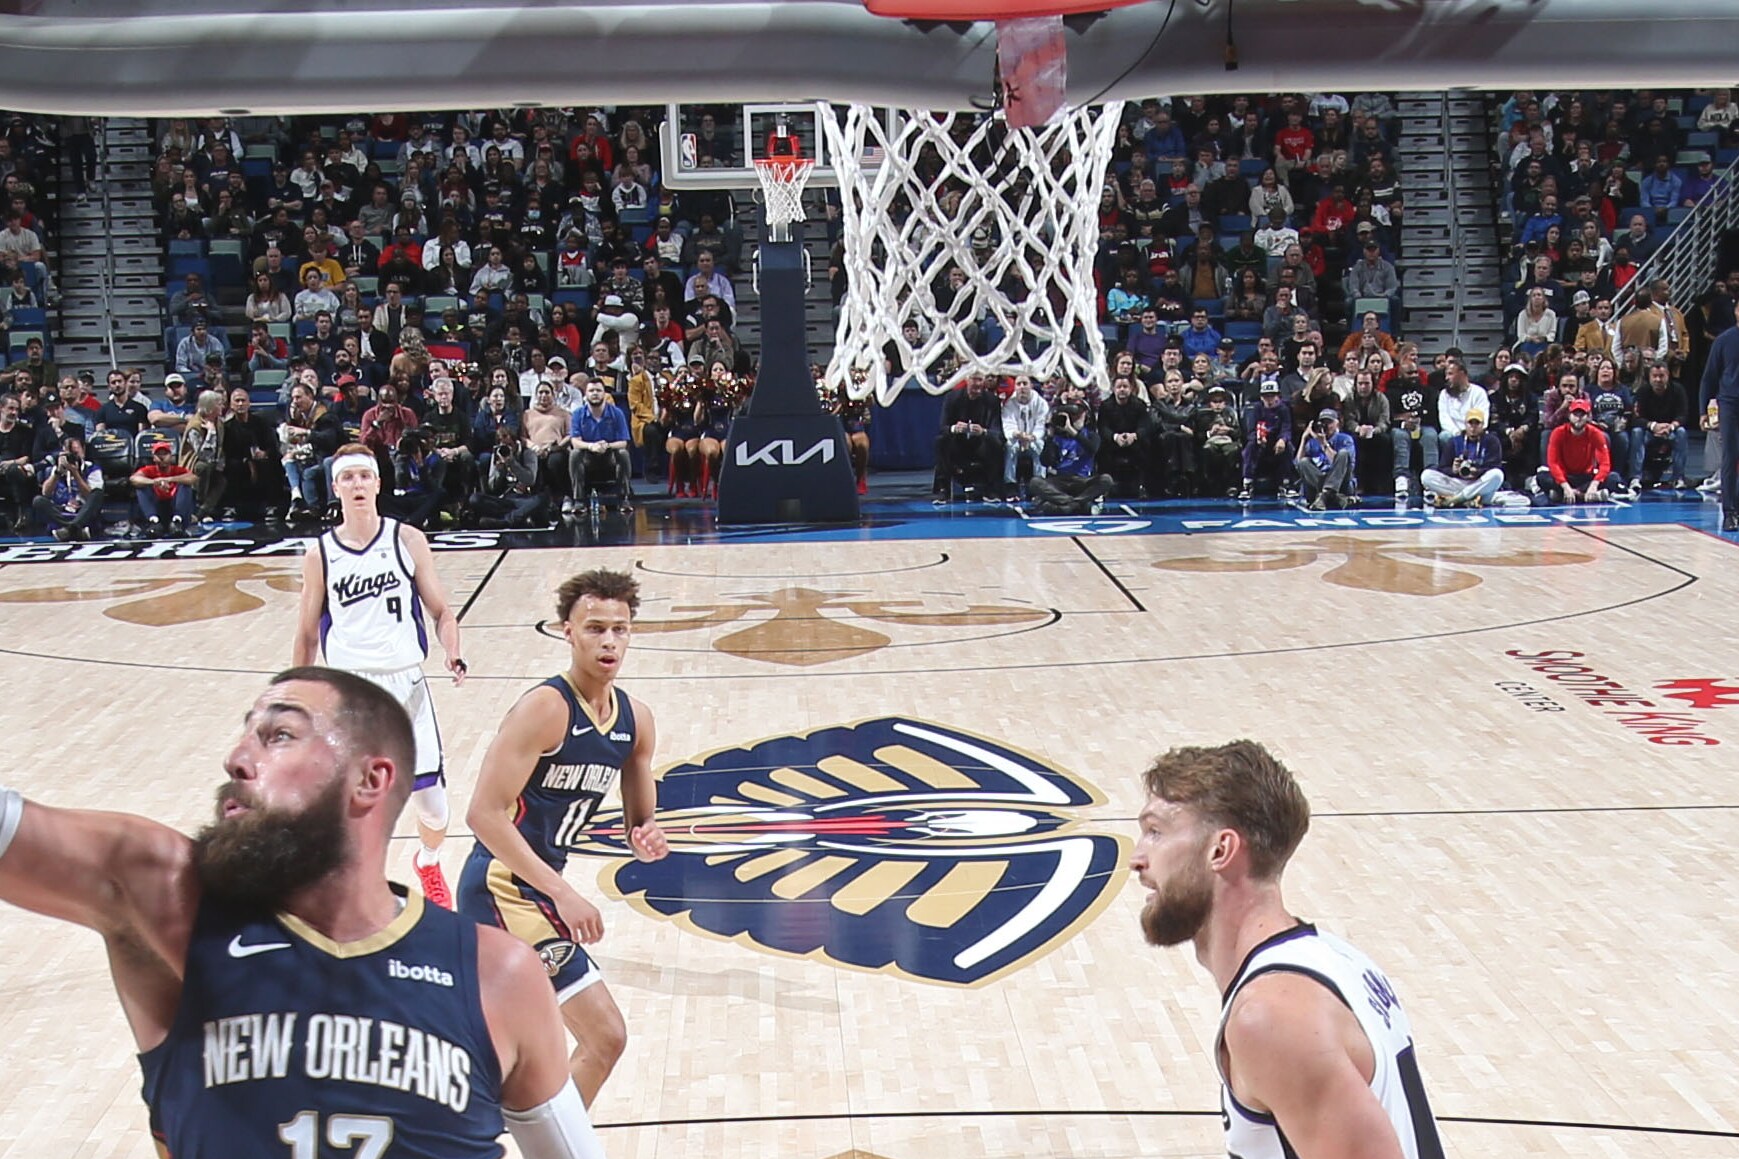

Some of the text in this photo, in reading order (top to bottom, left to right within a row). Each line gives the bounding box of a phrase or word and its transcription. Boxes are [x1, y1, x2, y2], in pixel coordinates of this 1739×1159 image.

[735, 438, 835, 466] KIA
[1181, 514, 1610, 529] FANDUEL
[332, 571, 401, 608] Kings
[386, 596, 402, 623] 9
[1494, 681, 1566, 712] CENTER
[1505, 650, 1721, 745] SMOOTHIE KING
[541, 763, 585, 790] NEW
[554, 799, 594, 846] 11
[388, 959, 454, 987] ibotta
[203, 1012, 471, 1113] NEW ORLEANS
